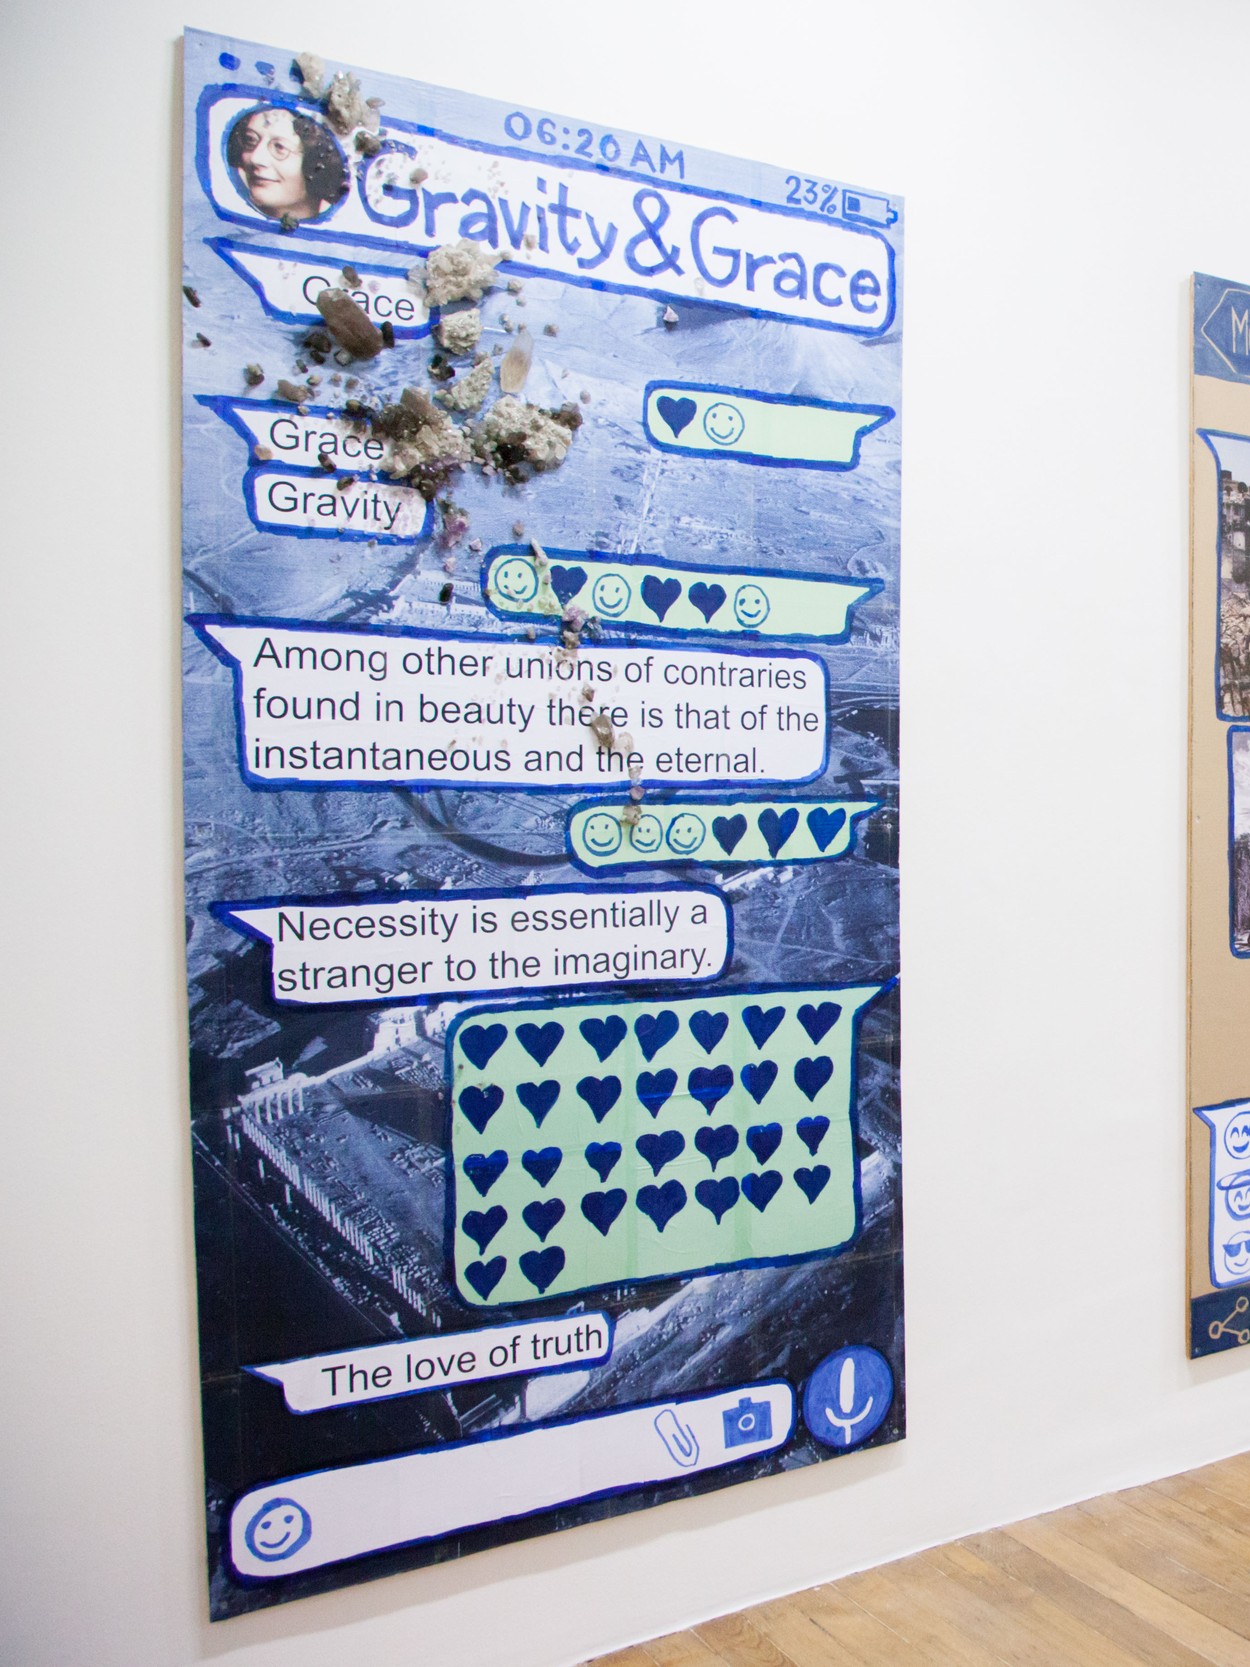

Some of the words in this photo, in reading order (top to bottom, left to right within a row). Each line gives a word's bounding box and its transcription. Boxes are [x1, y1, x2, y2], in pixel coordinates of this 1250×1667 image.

[504, 111, 621, 162] 06:20
[630, 139, 685, 179] AM
[785, 175, 839, 215] 23%
[302, 275, 415, 321] Gace
[269, 418, 385, 460] Grace
[268, 481, 403, 530] Gravity
[253, 637, 388, 680] Among
[402, 646, 493, 678] other
[506, 652, 613, 682] unions
[625, 656, 655, 683] of
[664, 660, 807, 690] contraries
[253, 688, 360, 722] found
[377, 692, 404, 722] in
[419, 694, 535, 733] beauty
[641, 701, 664, 729] is
[675, 703, 731, 730] that
[740, 706, 769, 731] of
[777, 707, 820, 732] the
[253, 739, 511, 772] instantaneous
[524, 744, 583, 772] and
[596, 745, 644, 772] the
[656, 747, 765, 774] eternal.
[278, 909, 458, 943] Necessity
[471, 911, 498, 934] is
[511, 899, 679, 932] essentially
[690, 904, 708, 925] a
[277, 955, 434, 993] stranger
[445, 953, 477, 982] to
[490, 949, 541, 978] the
[554, 944, 713, 982] imaginary.
[321, 1364, 393, 1397] The
[405, 1346, 477, 1382] love
[488, 1335, 521, 1366] of
[530, 1323, 603, 1361] truth
